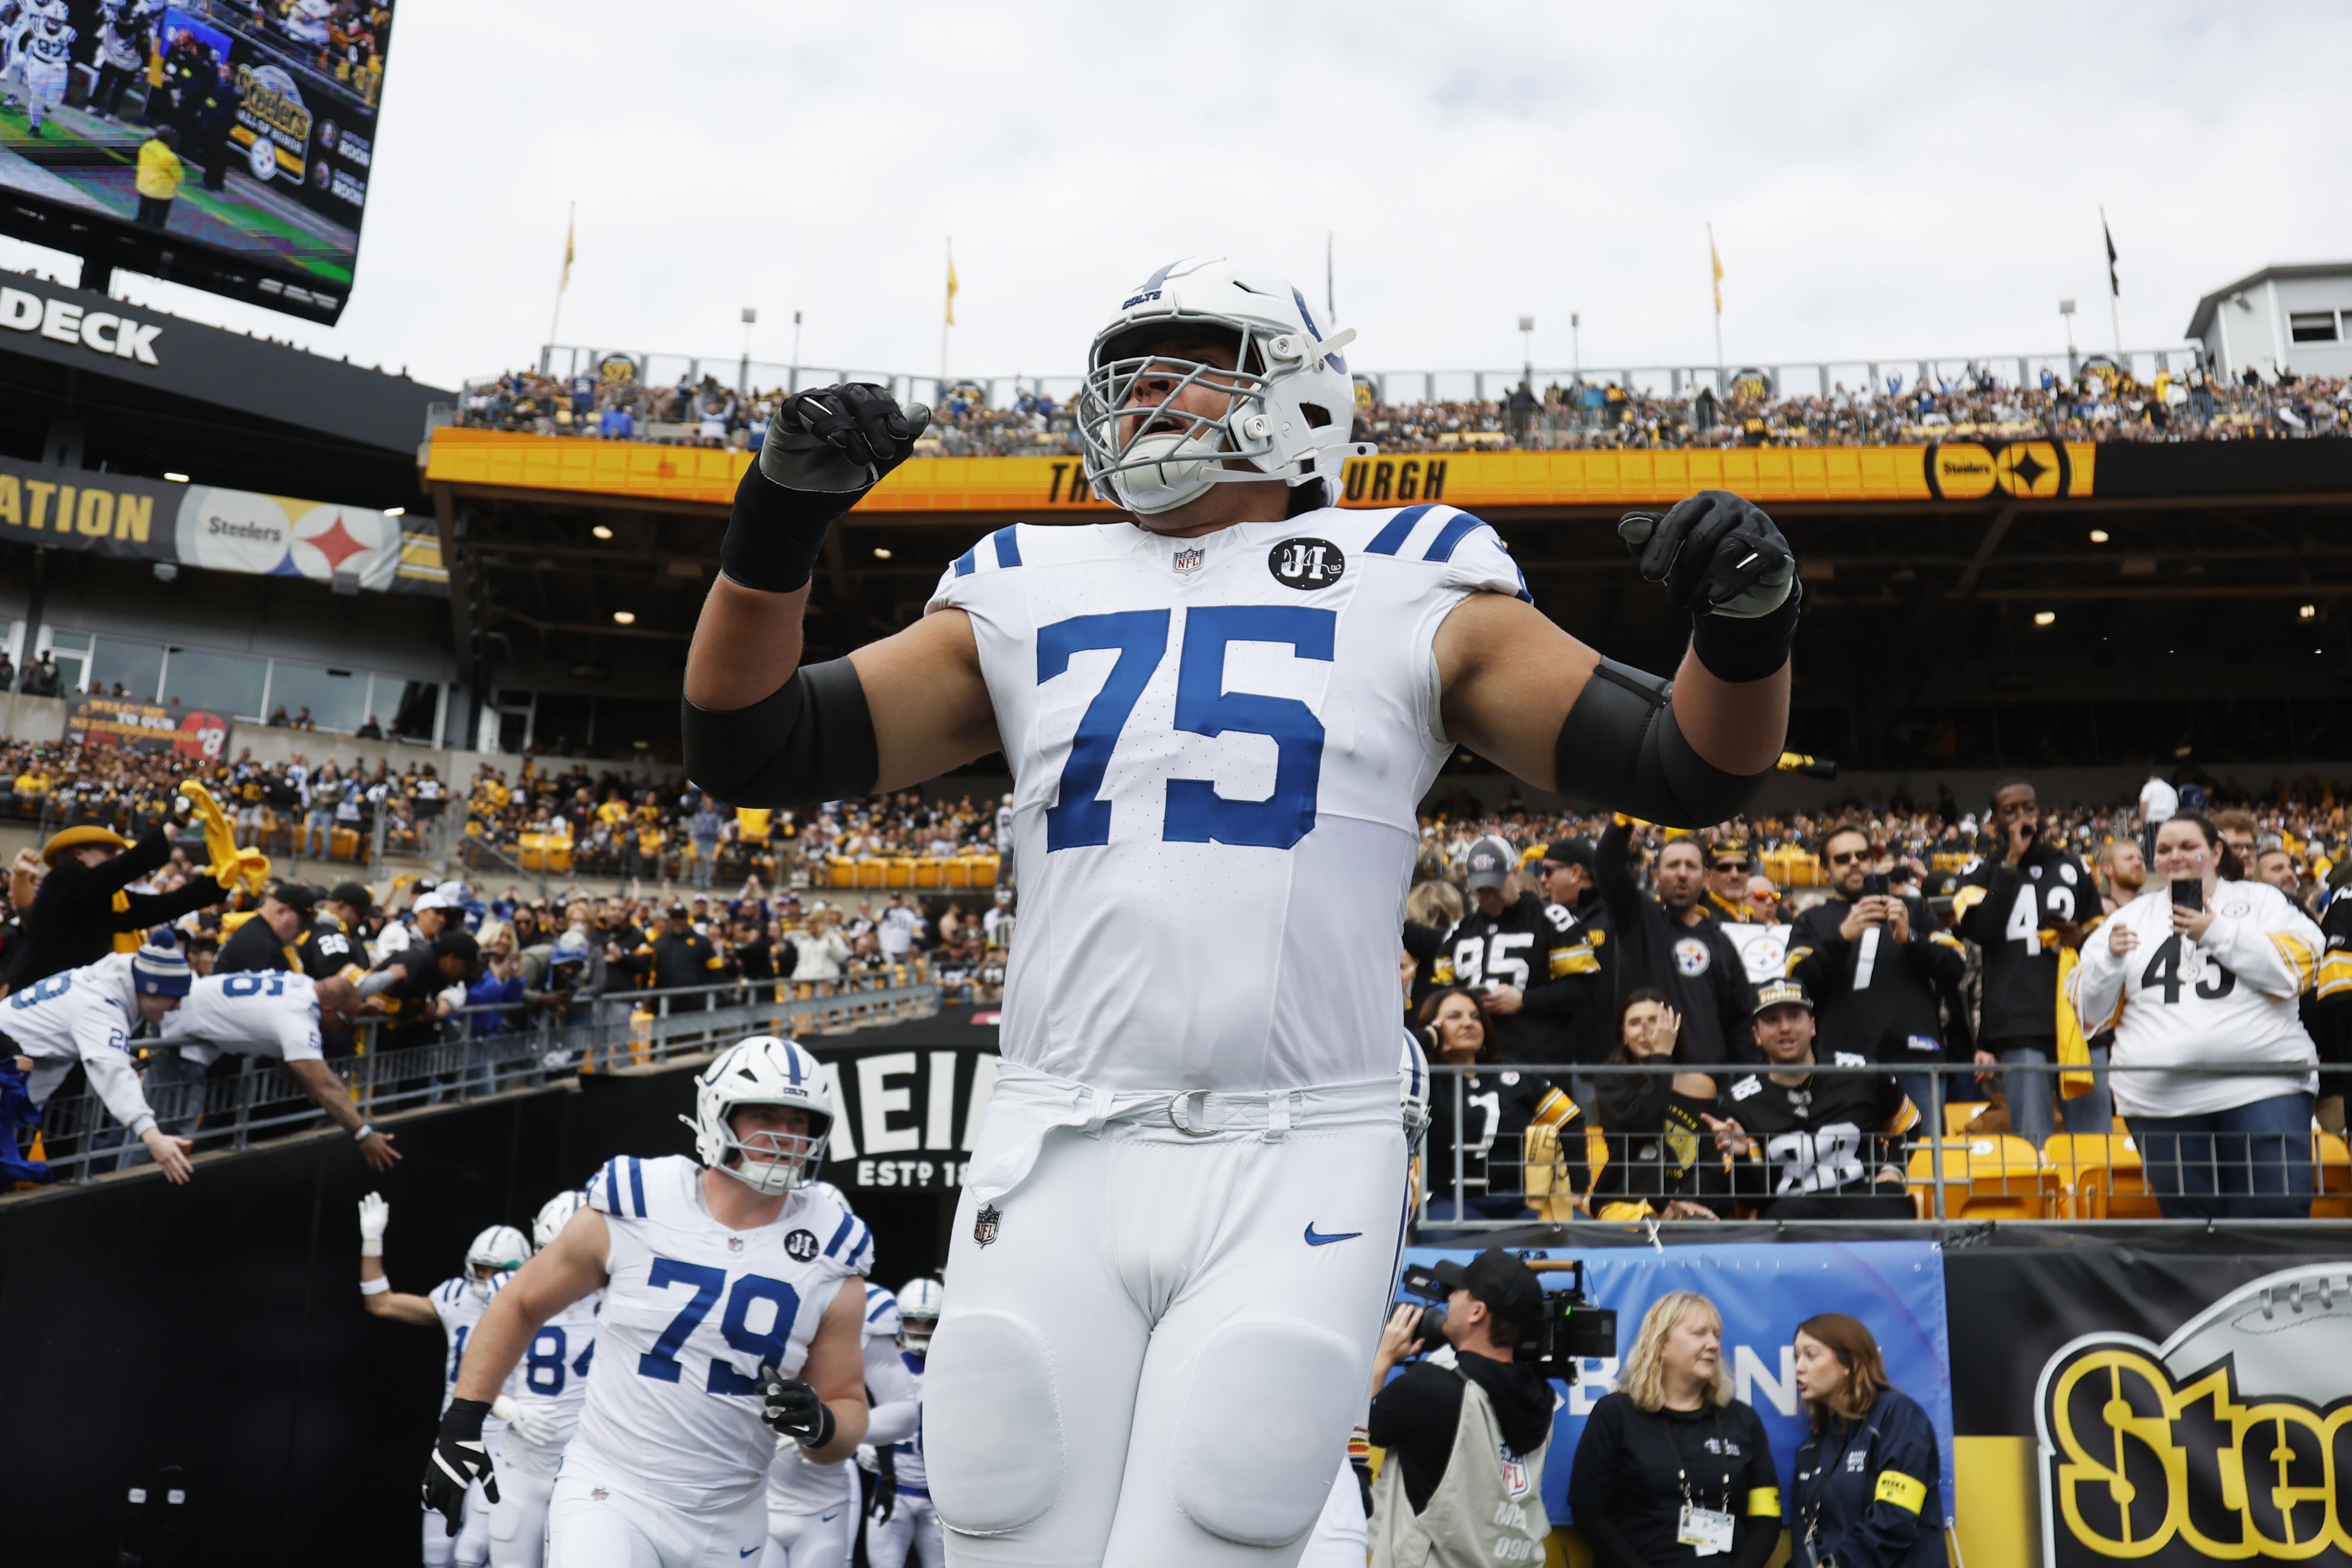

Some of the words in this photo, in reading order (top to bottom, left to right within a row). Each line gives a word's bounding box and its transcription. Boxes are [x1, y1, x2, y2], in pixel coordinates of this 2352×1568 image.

[1122, 290, 1162, 310] COLTS
[0, 286, 163, 366] DECK
[1354, 385, 1372, 407] 25
[1050, 463, 1089, 502] TH
[1346, 459, 1448, 501] URGH
[1943, 462, 1991, 475] Steelers
[0, 474, 154, 544] ATION
[209, 515, 282, 543] Steelers
[1177, 557, 1199, 569] NFL
[116, 712, 139, 725] TO
[140, 716, 175, 730] OUR
[1037, 606, 1337, 853] 75
[196, 728, 225, 755] #8
[1545, 903, 1579, 933] 9
[318, 933, 350, 956] 26
[1454, 933, 1534, 993] 95
[784, 1087, 809, 1098] COLTS
[976, 1224, 993, 1240] NFL
[638, 1258, 800, 1396] 79
[1494, 1536, 1532, 1561] 090
